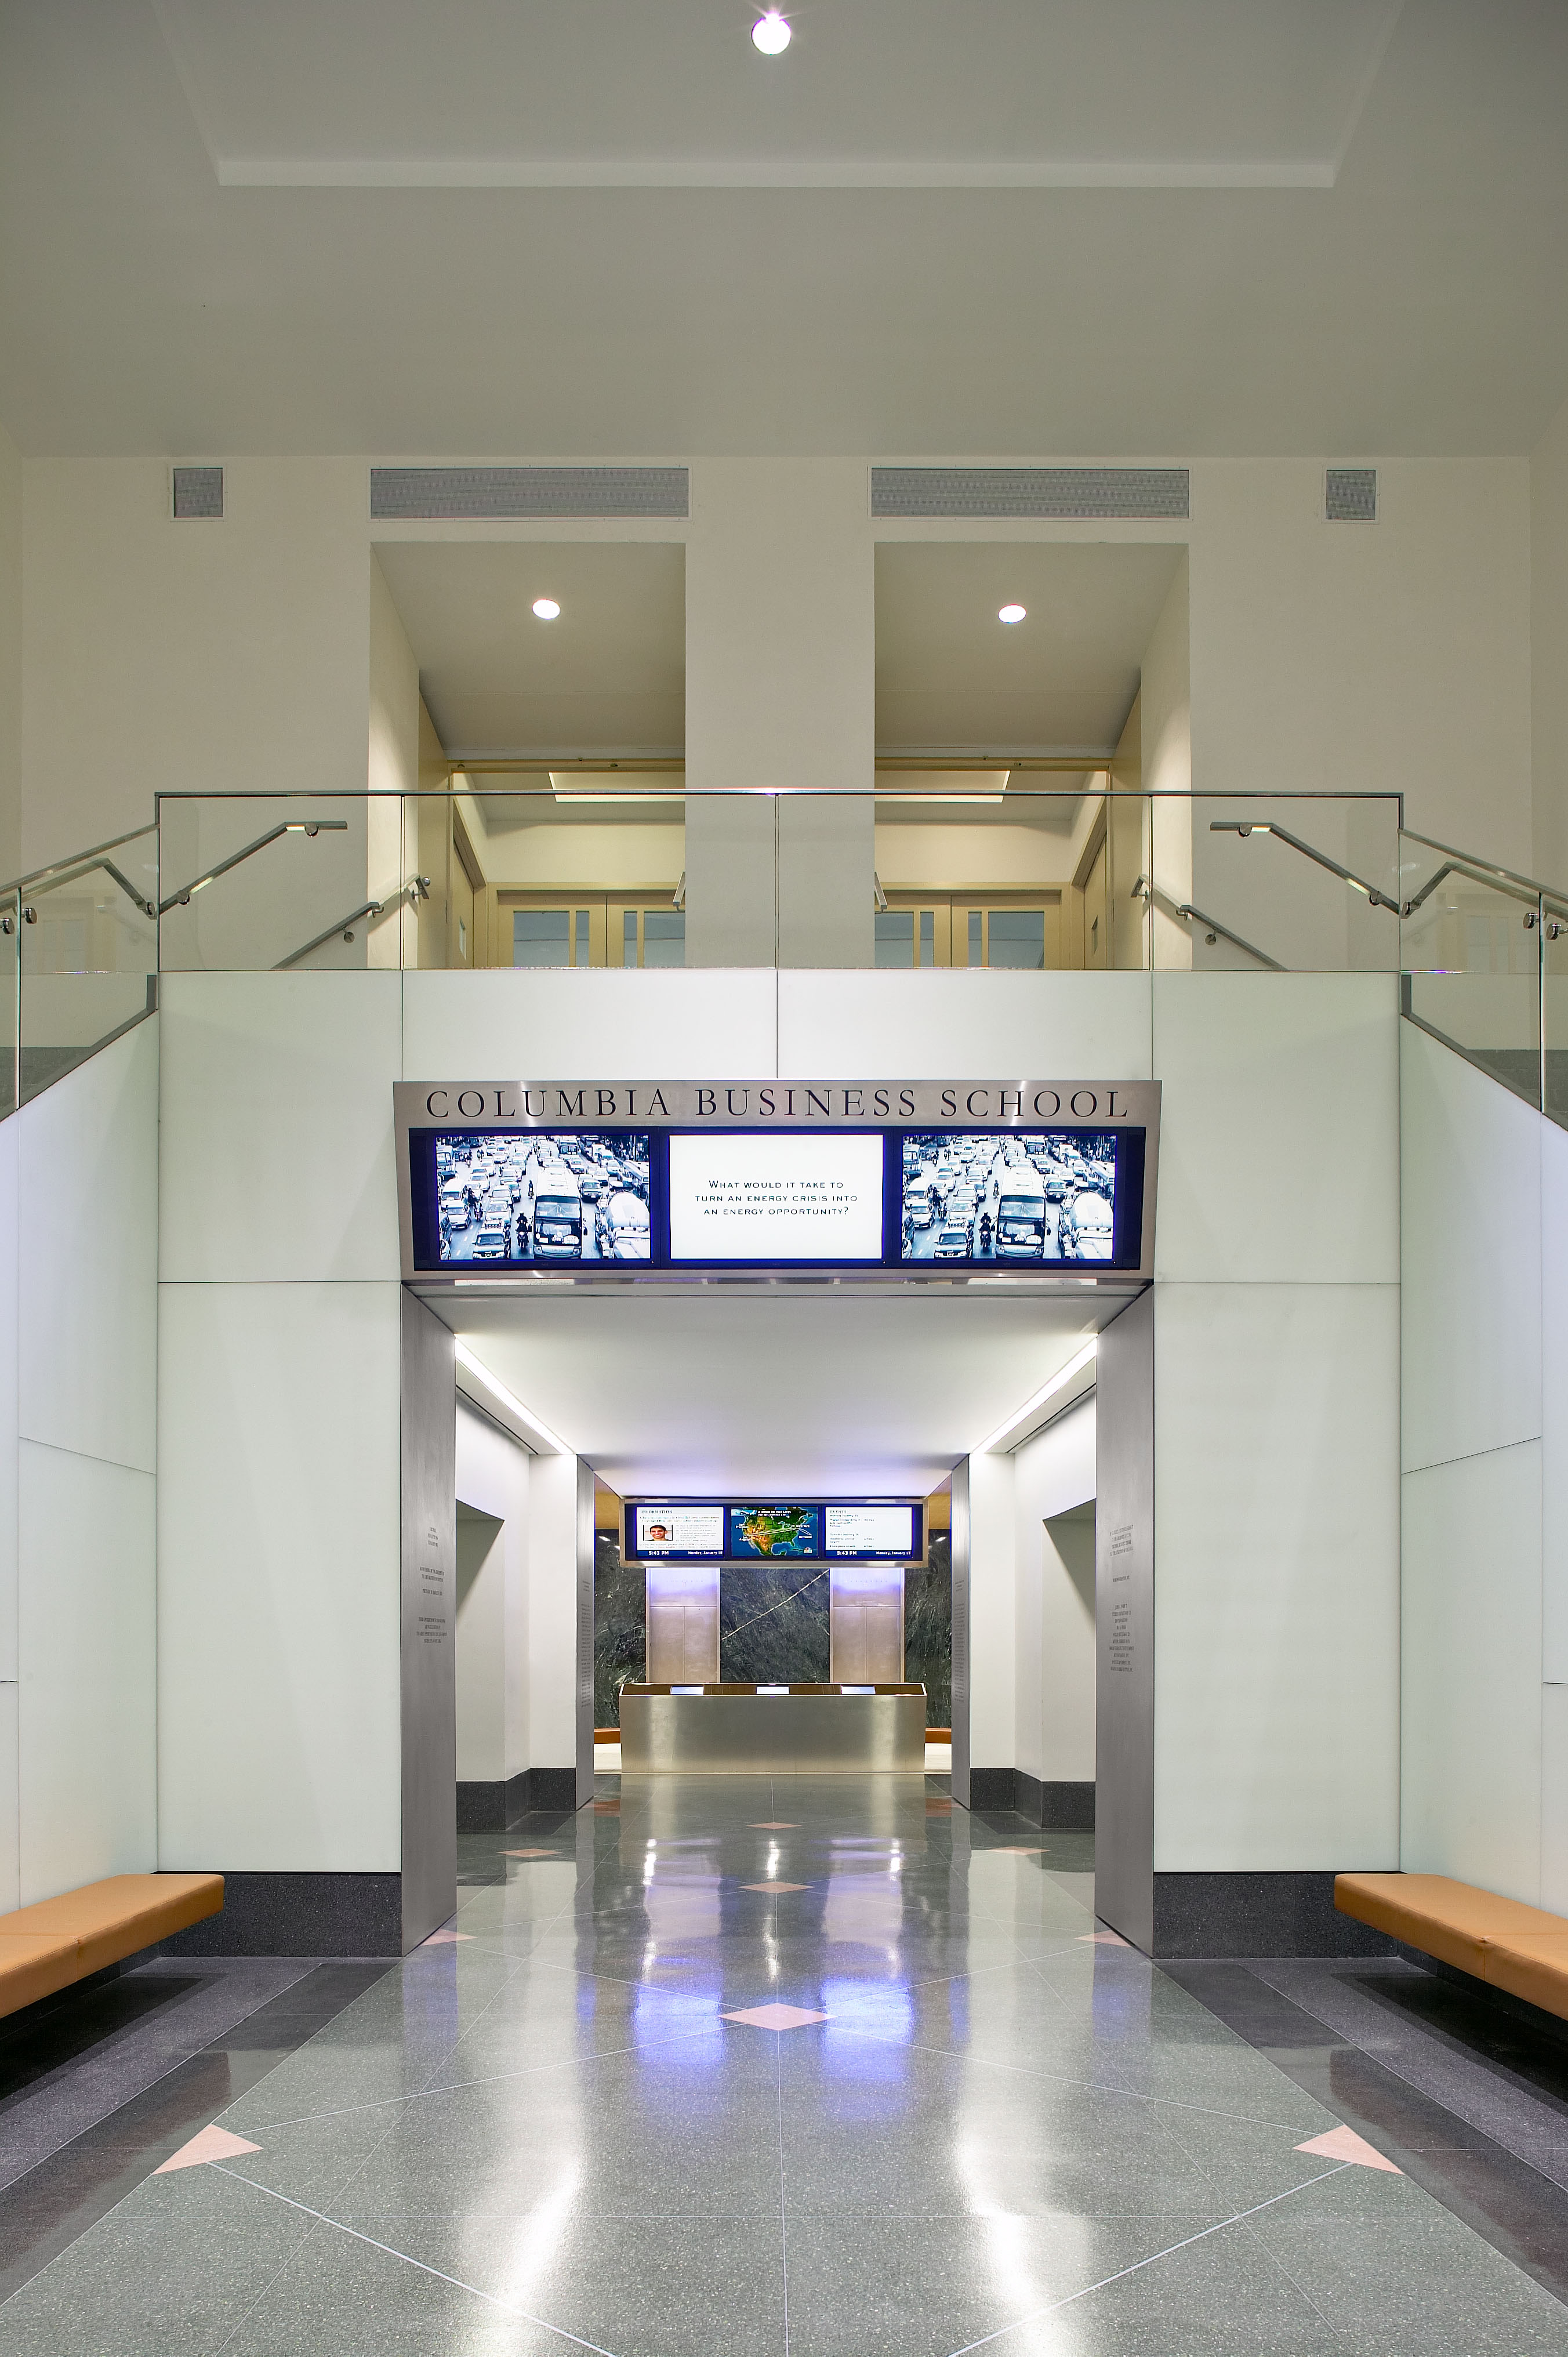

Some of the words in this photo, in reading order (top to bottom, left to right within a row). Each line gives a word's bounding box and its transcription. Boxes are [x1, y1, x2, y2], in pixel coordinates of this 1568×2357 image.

[426, 1089, 670, 1118] COLUMBIA
[695, 1089, 915, 1118] BUSINESS
[940, 1089, 1127, 1118] SCHOOL
[768, 1206, 848, 1215] OPPORTUNITY?
